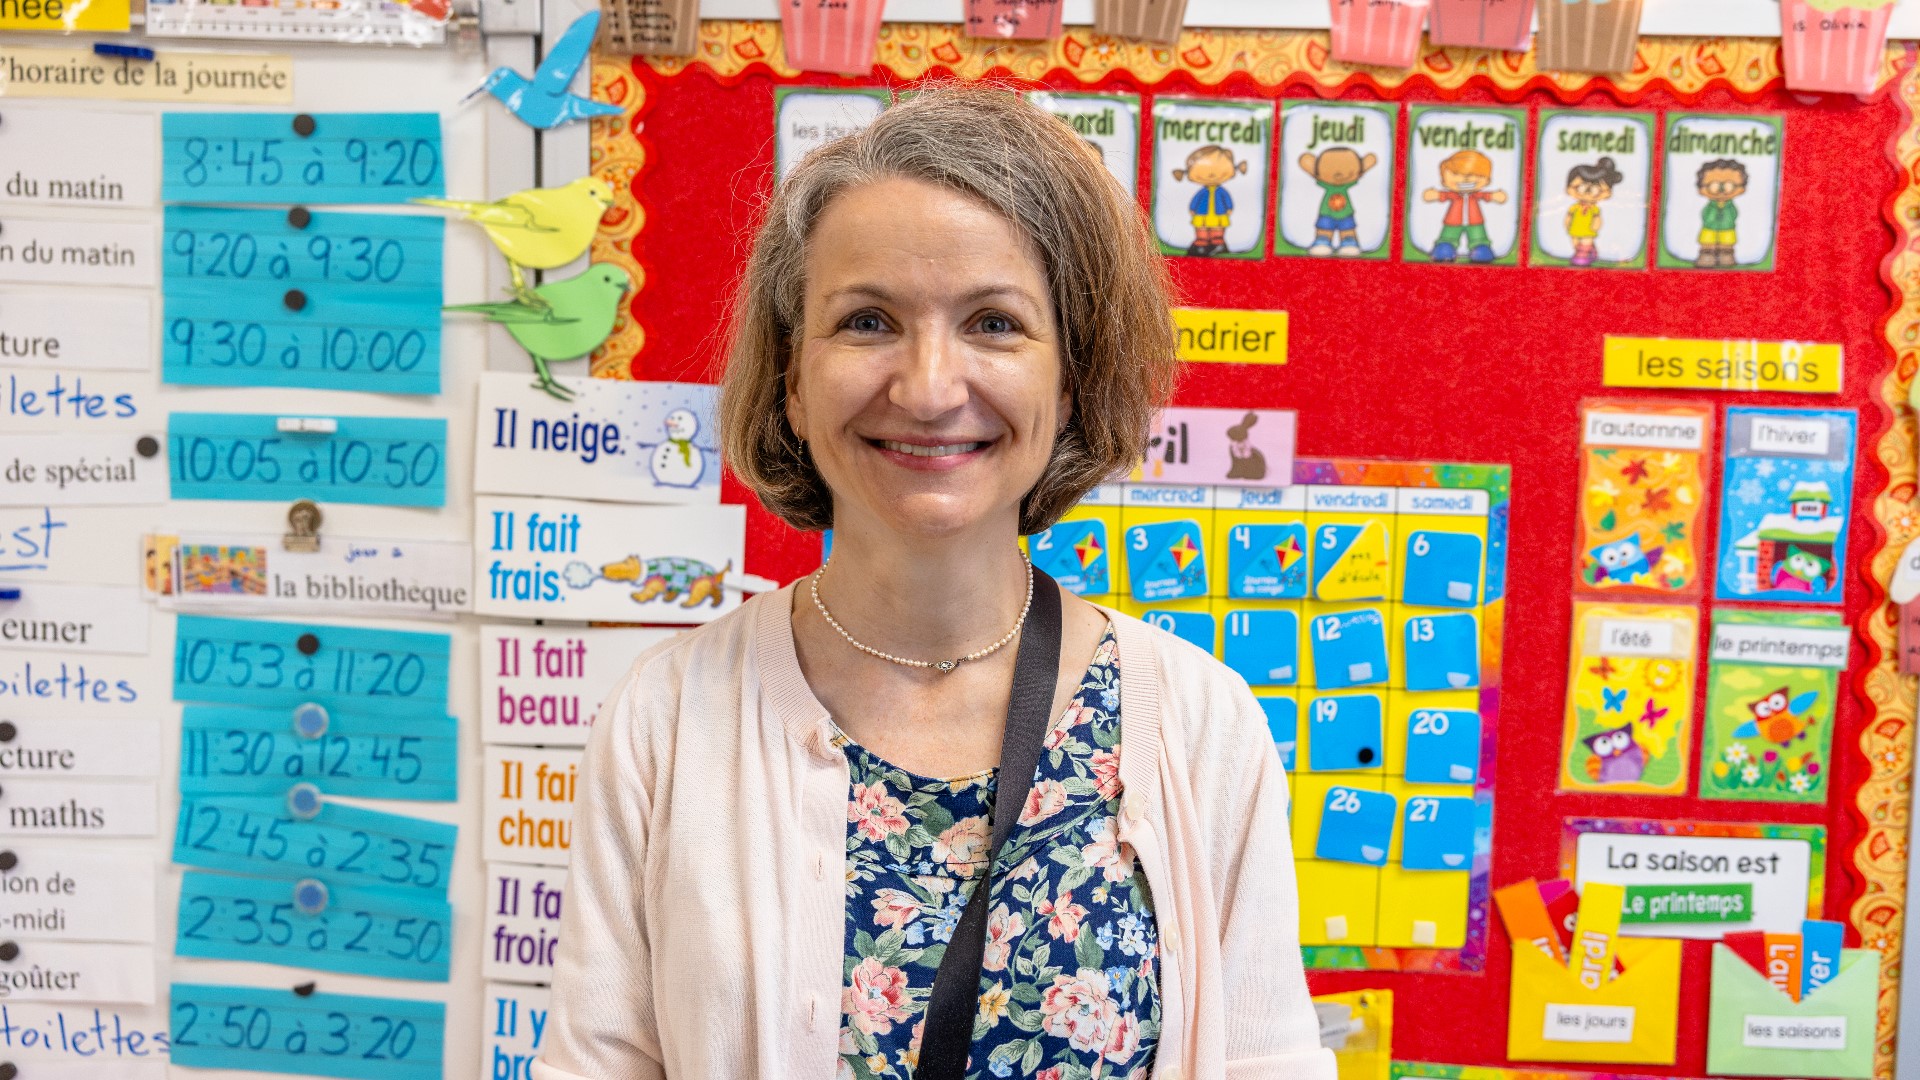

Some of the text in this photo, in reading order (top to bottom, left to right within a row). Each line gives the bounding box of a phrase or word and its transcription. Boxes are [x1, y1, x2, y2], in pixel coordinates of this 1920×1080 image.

[114, 58, 144, 85] de
[155, 61, 177, 87] la
[184, 63, 288, 94] journée
[1162, 114, 1262, 144] mercredi
[1307, 113, 1365, 149] jeudi
[1418, 121, 1516, 150] vendredi
[1557, 124, 1636, 153] samedi
[1668, 127, 1776, 156] dimanche
[182, 136, 439, 188] 8:45 à 9:20
[6, 172, 124, 200] du matin
[22, 239, 53, 263] du
[62, 243, 135, 266] matin
[171, 229, 406, 283] 9:20 à 9:30
[0, 332, 60, 359] ture
[169, 317, 427, 372] 9:30 à 10:00
[1637, 349, 1819, 383] les saisons
[0, 374, 137, 418] lettes
[493, 408, 626, 464] Il neige.
[1590, 420, 1698, 440] l'automne
[1757, 424, 1818, 445] l'hiver
[5, 457, 137, 489] de spécial
[176, 436, 440, 488] 10:05 à 10:50
[1130, 486, 1206, 503] mercredi
[1314, 493, 1389, 508] vendredi
[1411, 495, 1474, 510] samedi
[491, 511, 582, 552] Il fait
[1036, 528, 1054, 551] 2
[1132, 528, 1150, 551] 3
[1235, 527, 1251, 550] 4
[1321, 527, 1338, 550] 5
[1413, 534, 1431, 557] 6
[273, 574, 468, 611] la bibliothèque
[488, 560, 566, 602] frais.
[1, 617, 93, 644] euner
[1231, 612, 1249, 637] 11
[1316, 616, 1342, 641] 12
[1411, 618, 1435, 642] 13
[1611, 628, 1653, 646] l'été
[497, 637, 588, 679] Il fait
[1714, 634, 1845, 660] le printemps
[179, 638, 425, 697] 10:53 à 11:20
[1315, 699, 1338, 723] 19
[1412, 711, 1450, 736] 20
[0, 745, 75, 769] cture
[187, 730, 274, 778] 11:30
[316, 735, 423, 784] 12:45
[500, 761, 578, 803] Il fai
[9, 799, 105, 829] maths
[1329, 789, 1361, 814] 26
[1409, 799, 1440, 822] 27
[179, 801, 447, 888] 12:45 à 2:35
[1607, 847, 1781, 875] La saison est
[1, 871, 76, 895] ion de
[496, 877, 562, 920] Il fa
[1650, 893, 1745, 918] printemps
[0, 909, 66, 931] -midi
[183, 896, 443, 963] 2:35 à 2:50
[0, 964, 80, 997] goûter
[0, 1004, 171, 1057] toilettes
[174, 1001, 417, 1061] 2:50 à 3:20
[494, 997, 547, 1049] Il y
[1556, 1012, 1628, 1031] les jours
[1748, 1021, 1841, 1040] les saisons
